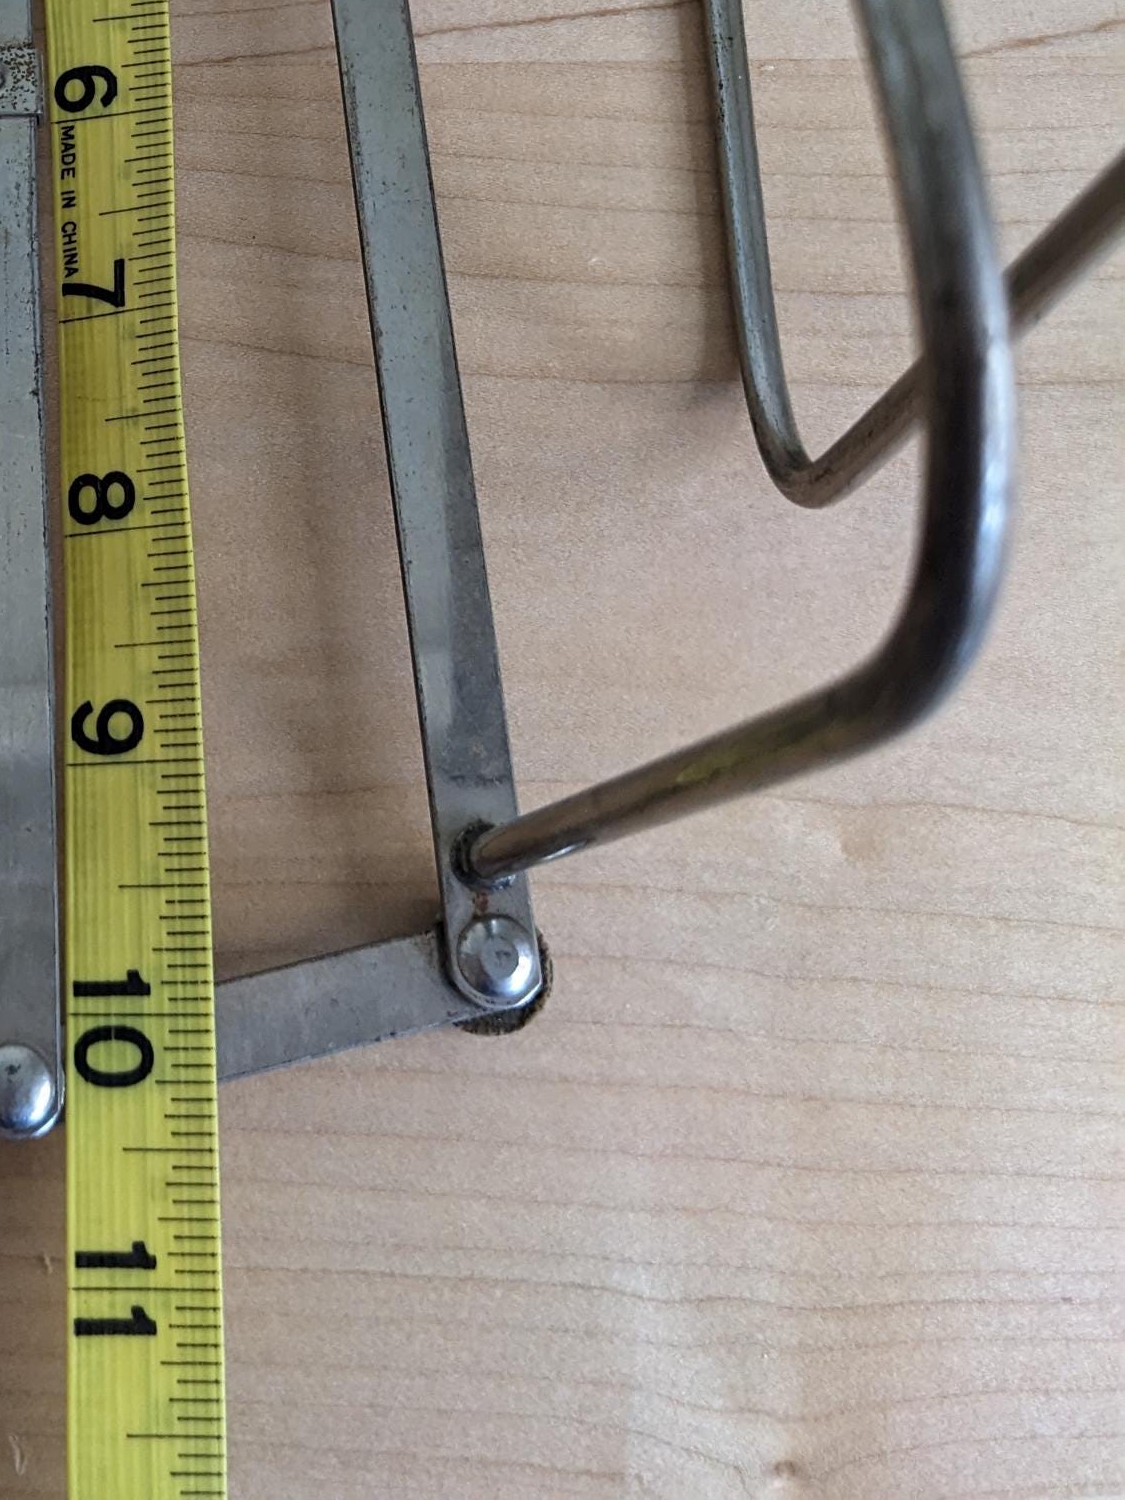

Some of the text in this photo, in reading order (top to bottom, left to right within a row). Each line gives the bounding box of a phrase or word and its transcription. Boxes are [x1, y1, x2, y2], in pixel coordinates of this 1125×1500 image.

[54, 65, 118, 112] 6
[61, 125, 79, 278] MADE IN CHINA
[62, 258, 126, 308] 7
[68, 470, 136, 525] 8
[71, 699, 145, 756] 9
